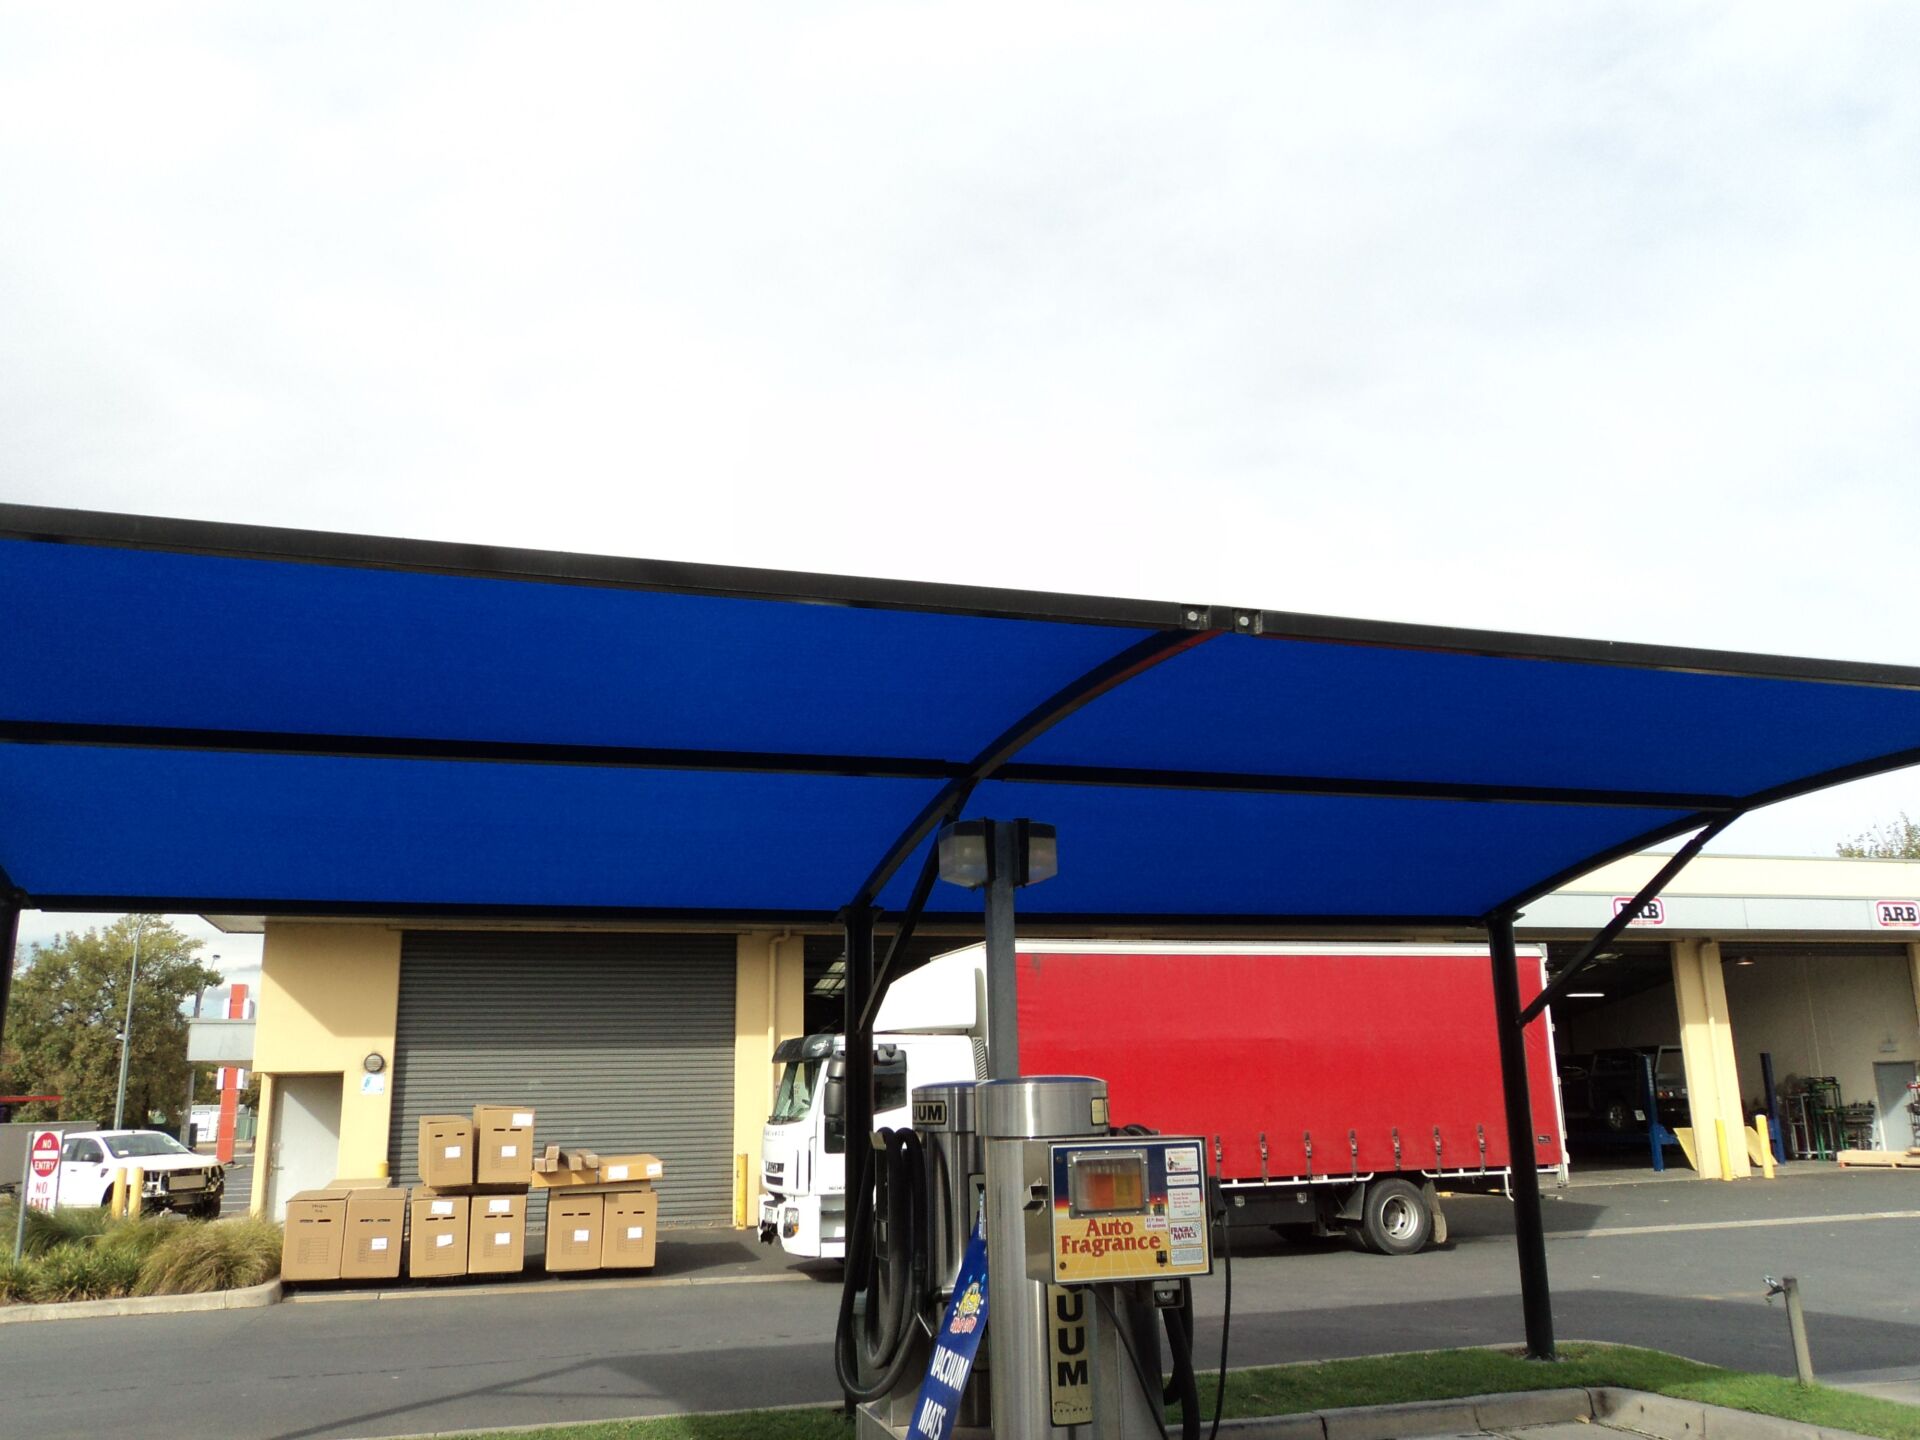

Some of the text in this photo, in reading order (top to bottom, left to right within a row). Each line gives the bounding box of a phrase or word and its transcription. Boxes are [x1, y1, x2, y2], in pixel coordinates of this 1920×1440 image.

[1882, 906, 1917, 922] ARB
[42, 1139, 52, 1149] NO
[34, 1161, 55, 1171] ENTRY
[35, 1182, 48, 1194] NO
[1086, 1218, 1134, 1237] Auto
[1061, 1235, 1161, 1257] Fragrance
[930, 1344, 969, 1392] VACUUM
[918, 1397, 947, 1440] MATS
